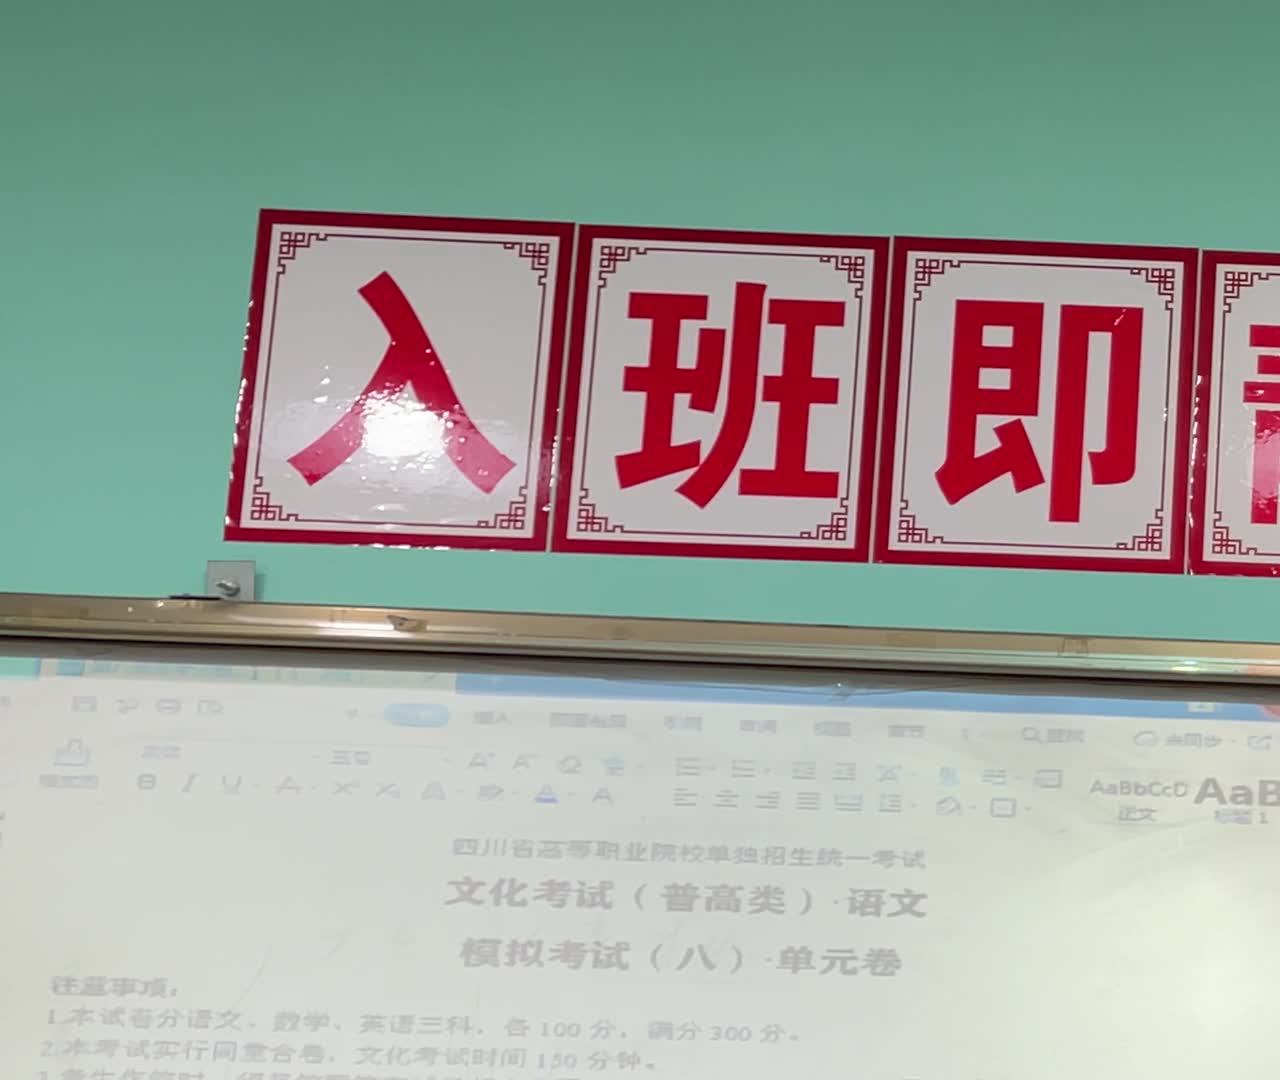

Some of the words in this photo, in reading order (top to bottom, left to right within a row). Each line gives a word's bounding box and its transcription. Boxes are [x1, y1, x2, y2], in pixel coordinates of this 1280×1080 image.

[452, 837, 928, 869] 四川省高等职业院校单独招生统一考试
